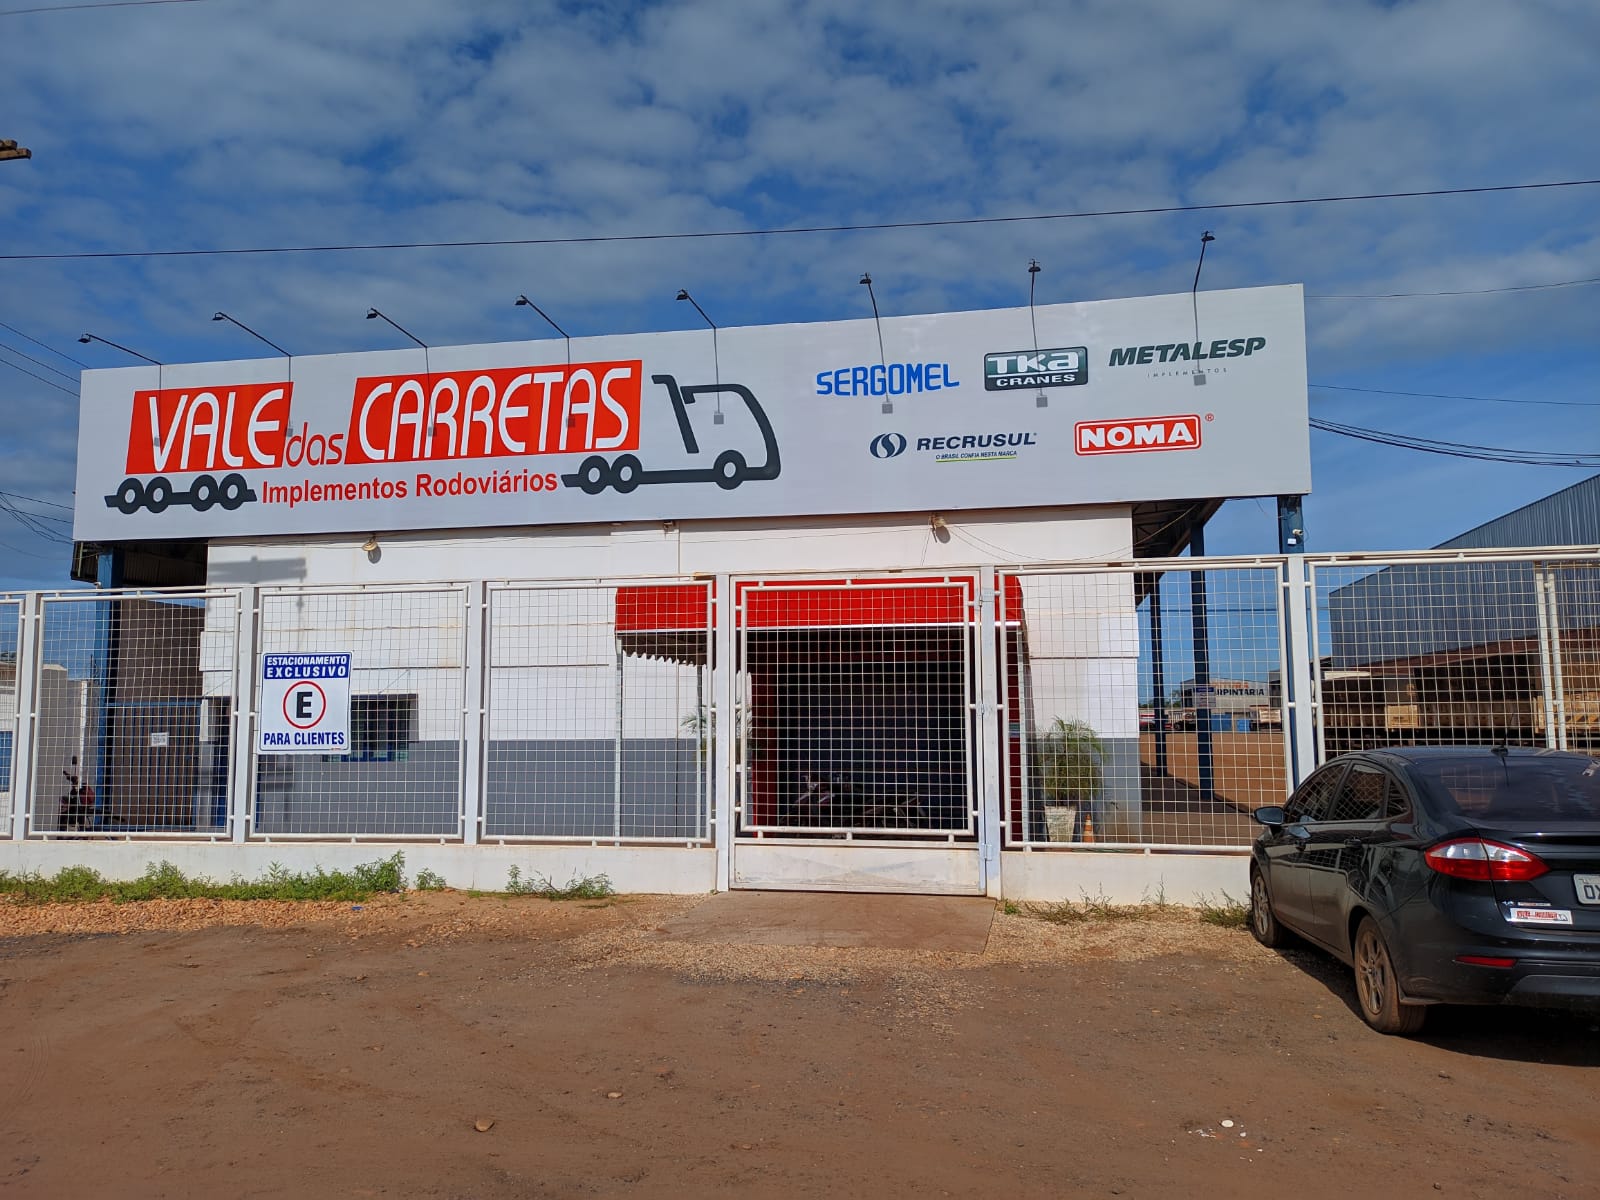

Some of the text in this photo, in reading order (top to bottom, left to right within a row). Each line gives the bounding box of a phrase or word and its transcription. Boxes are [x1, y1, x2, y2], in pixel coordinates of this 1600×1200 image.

[1108, 337, 1266, 366] METALESP
[816, 363, 960, 396] SERGOMEL
[996, 374, 1076, 387] CRANES
[149, 367, 632, 472] VALE das CARRETAS
[917, 432, 1036, 451] RECRUSUL
[1081, 422, 1194, 449] NOMA
[262, 467, 558, 508] Implementos Rodoviários
[266, 655, 347, 667] ESTACIONAMENTO
[266, 666, 346, 678] EXCLUSIVO
[1216, 688, 1265, 696] RPINTARIA
[296, 691, 313, 718] E
[263, 731, 345, 746] PARA CLIENTES
